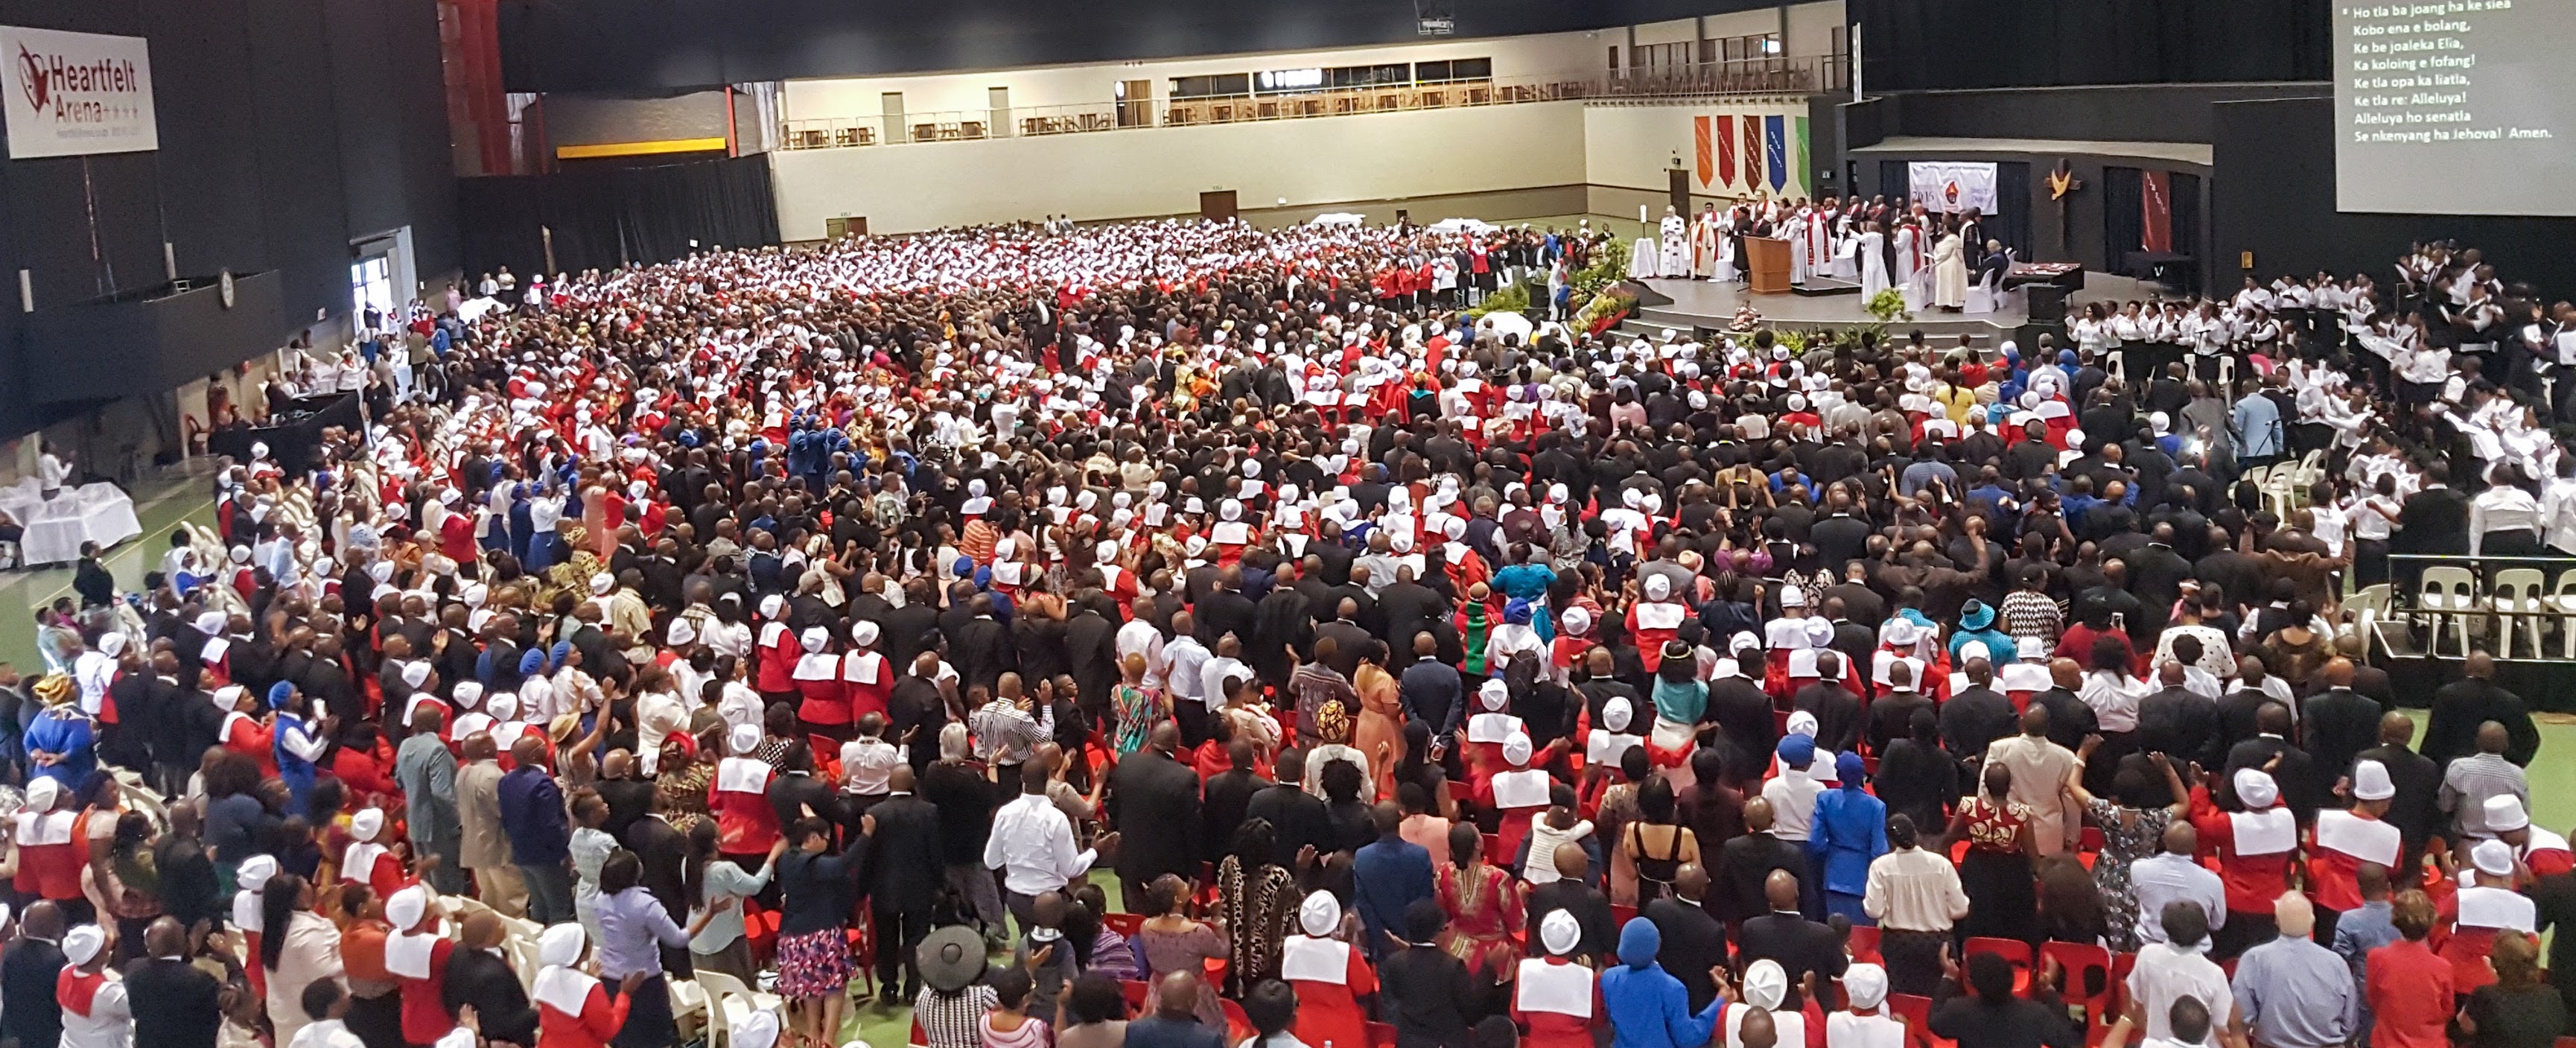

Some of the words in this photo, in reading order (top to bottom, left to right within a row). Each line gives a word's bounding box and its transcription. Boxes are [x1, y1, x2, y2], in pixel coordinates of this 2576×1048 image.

[2353, 7, 2370, 18] Ho
[2373, 6, 2389, 17] tla
[2392, 4, 2408, 16] ba
[2410, 3, 2446, 17] joang
[2448, 1, 2464, 12] ha
[2467, 0, 2483, 10] ke
[2353, 25, 2385, 36] Kobo
[2388, 25, 2410, 34] ena
[2413, 24, 2420, 33] e
[2424, 19, 2470, 32] bolang,
[2353, 42, 2370, 54] Ke
[2371, 41, 2388, 53] be
[2390, 39, 2435, 54] joaleka
[2437, 37, 2464, 50] Elia,
[2353, 60, 2370, 71] Ka
[2371, 58, 2417, 71] koloing
[2420, 59, 2428, 69] e
[2430, 54, 2475, 69] fofang!
[50, 54, 137, 92] Heartfelt
[2354, 78, 2370, 89] Ke
[2372, 77, 2388, 88] tla
[2391, 77, 2414, 89] opa
[2417, 75, 2432, 86] ka
[2435, 74, 2470, 86] liatla,
[2354, 95, 2370, 107] Ke
[2372, 94, 2388, 106] tla
[2411, 92, 2467, 106] Alleluya!
[55, 94, 102, 123] Arena
[2354, 112, 2403, 126] Alleluya
[2406, 111, 2423, 123] ho
[2425, 110, 2471, 122] senatla
[2355, 131, 2370, 142] Se
[2372, 130, 2431, 143] nkenyang
[2434, 128, 2449, 141] ha
[2453, 127, 2502, 139] Jehova!
[2509, 127, 2552, 139] Amen.
